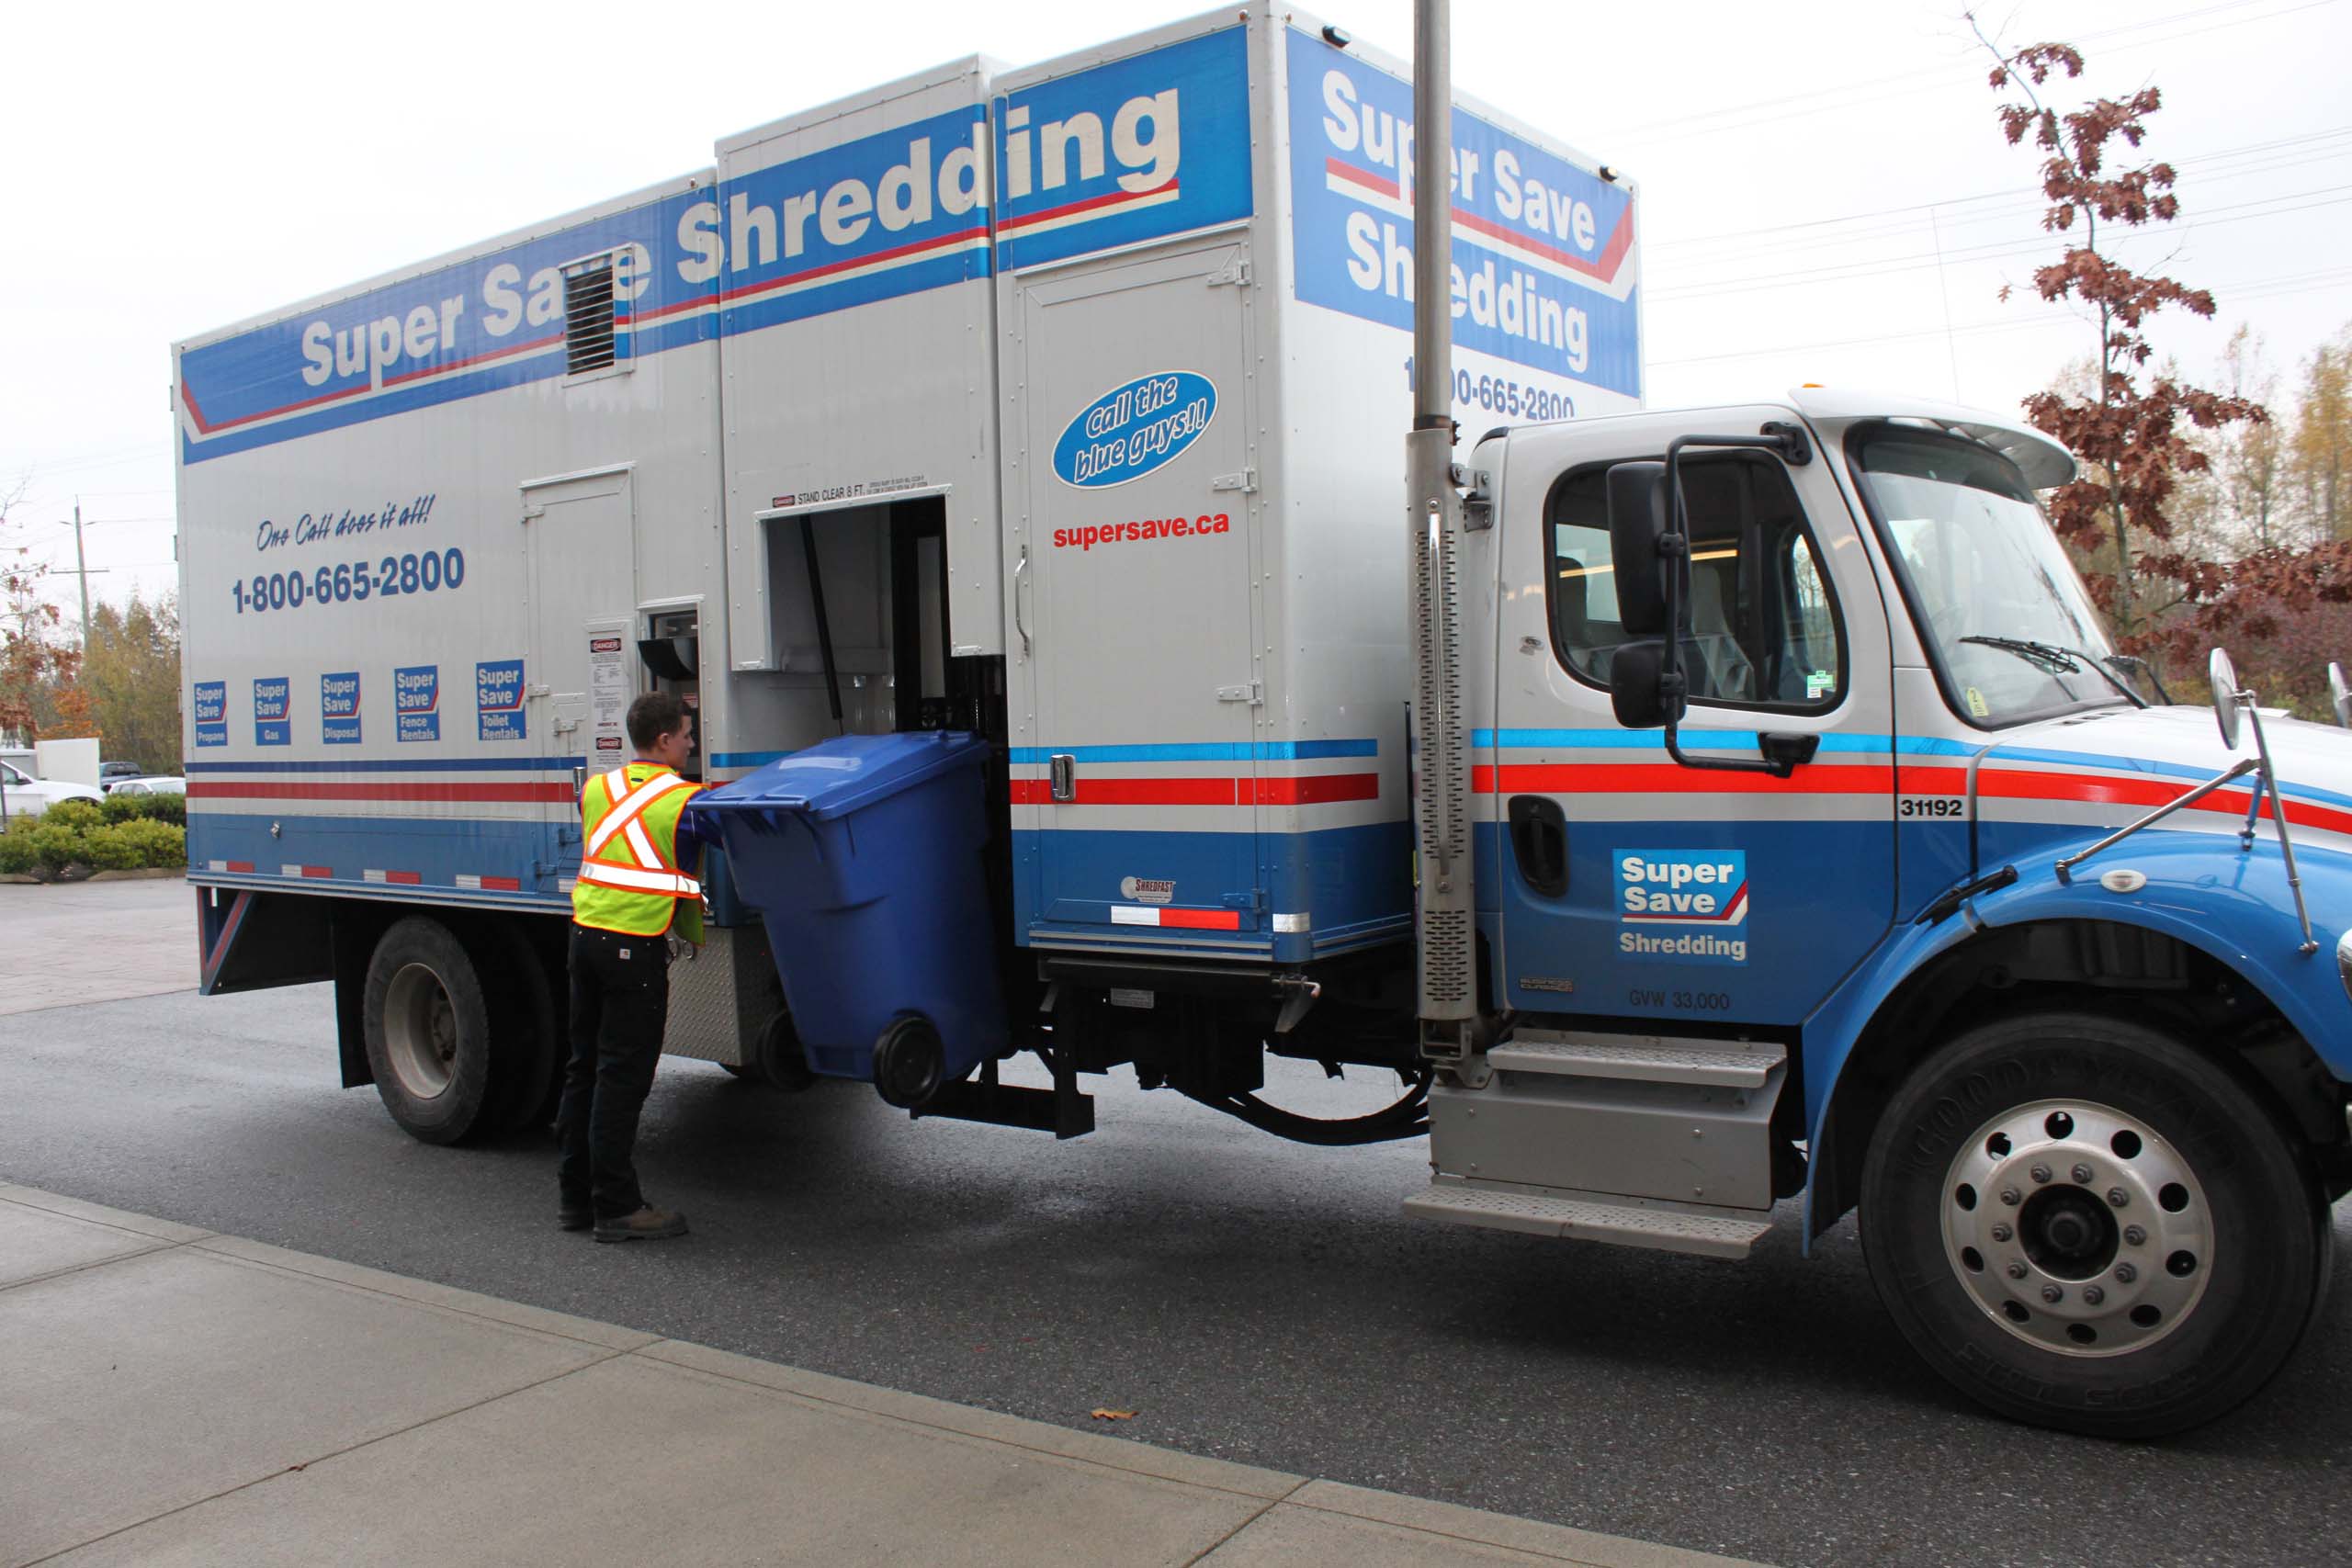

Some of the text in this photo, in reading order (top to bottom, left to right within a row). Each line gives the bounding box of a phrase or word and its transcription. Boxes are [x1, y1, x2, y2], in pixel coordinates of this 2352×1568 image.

[1494, 148, 1596, 252] Save
[301, 87, 1181, 391] Super Sae Shredding
[1086, 376, 1178, 439] Call the
[1073, 397, 1206, 483] blue guys!!
[797, 491, 820, 505] STAND
[821, 487, 845, 503] CLEAR
[846, 485, 853, 498] 8
[854, 484, 865, 497] FT.
[256, 493, 436, 552] One Call does it all!
[1053, 513, 1230, 551] supersave.ca
[232, 547, 466, 615] 1-800-665-2800
[323, 678, 356, 697] Super
[397, 672, 435, 692] Super
[479, 668, 520, 688] Super
[196, 687, 223, 705] Super
[255, 682, 287, 701] Super
[398, 691, 430, 707] Save
[480, 688, 514, 705] Save
[197, 704, 220, 718] Save
[256, 701, 282, 715] Save
[323, 696, 352, 712] Save
[400, 716, 427, 728] Fence
[482, 715, 509, 727] Toilet
[198, 731, 225, 744] Propane
[264, 730, 279, 741] Gas
[324, 727, 359, 740] Disposal
[401, 728, 435, 740] Rentals
[482, 728, 520, 740] Rentals
[1900, 798, 1962, 817] 31192
[1622, 856, 1735, 890] Super
[1623, 886, 1716, 914] Save
[1620, 932, 1746, 961] Shredding
[1629, 989, 1731, 1010] GVW 33,000
